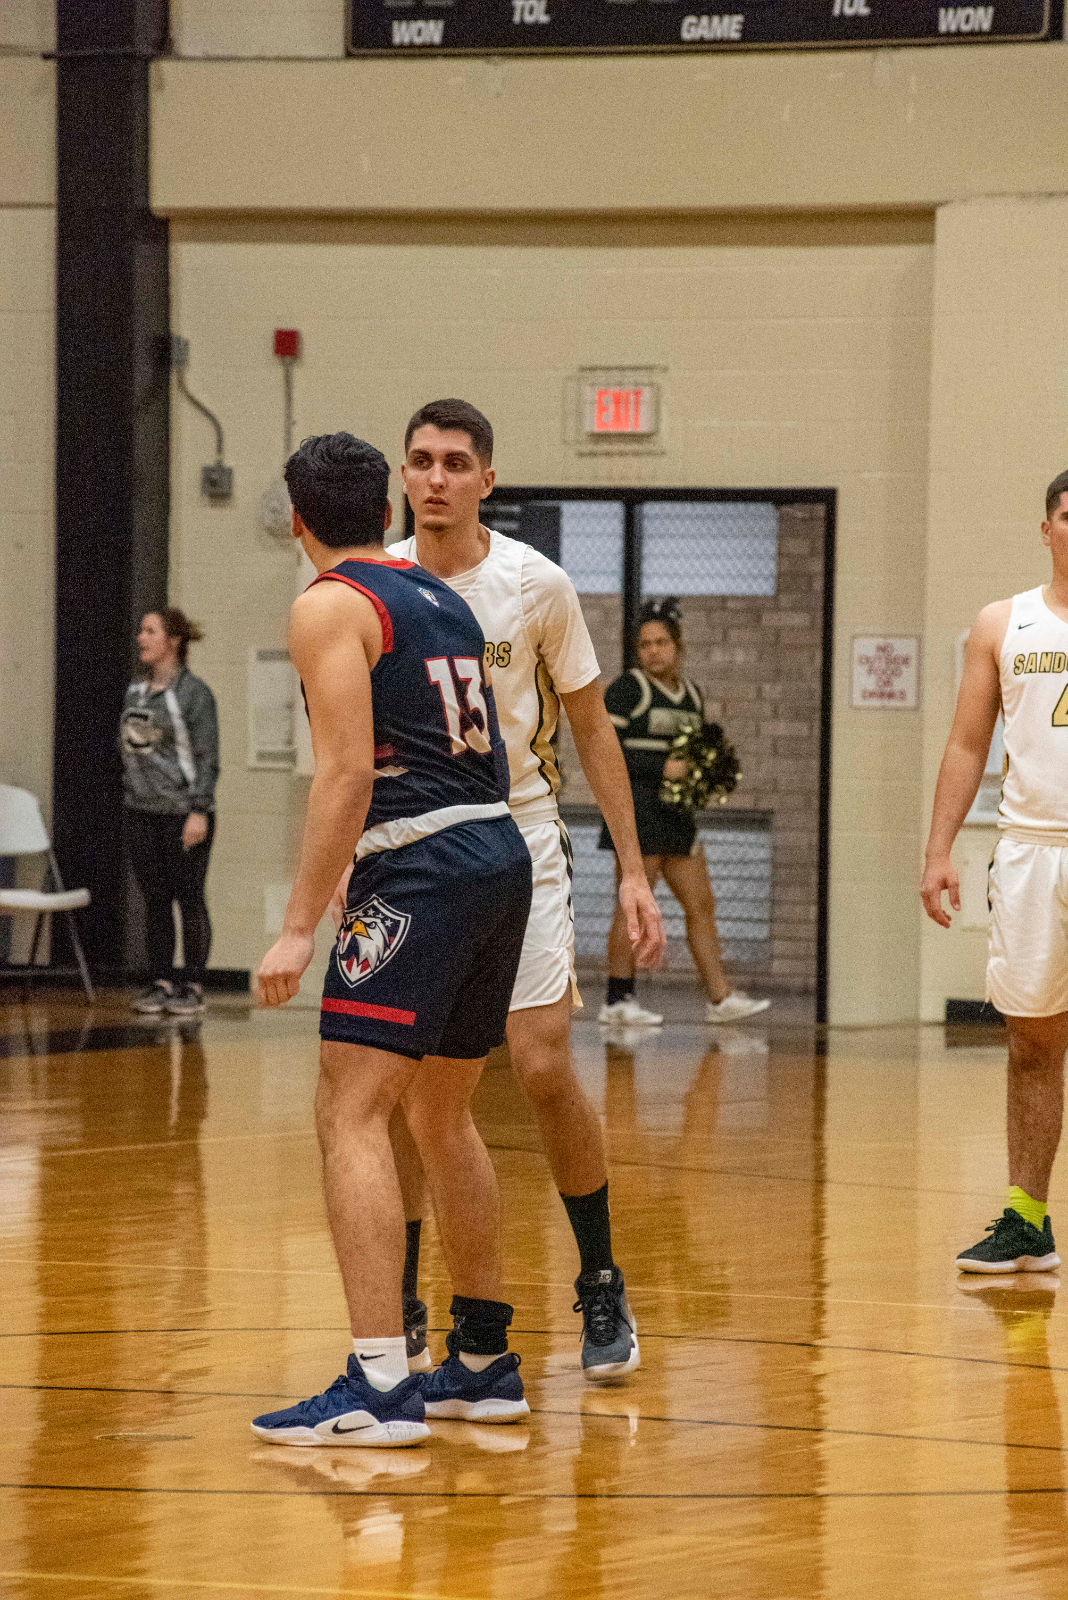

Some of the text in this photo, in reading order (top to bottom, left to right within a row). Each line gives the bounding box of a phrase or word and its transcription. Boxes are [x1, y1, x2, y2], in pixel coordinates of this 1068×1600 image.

[512, 0, 551, 24] TOL
[938, 6, 995, 33] WON
[391, 20, 445, 46] WON
[680, 14, 744, 42] GAME
[595, 389, 643, 432] EXIT
[1013, 651, 1068, 676] SAND
[424, 655, 493, 755] 13
